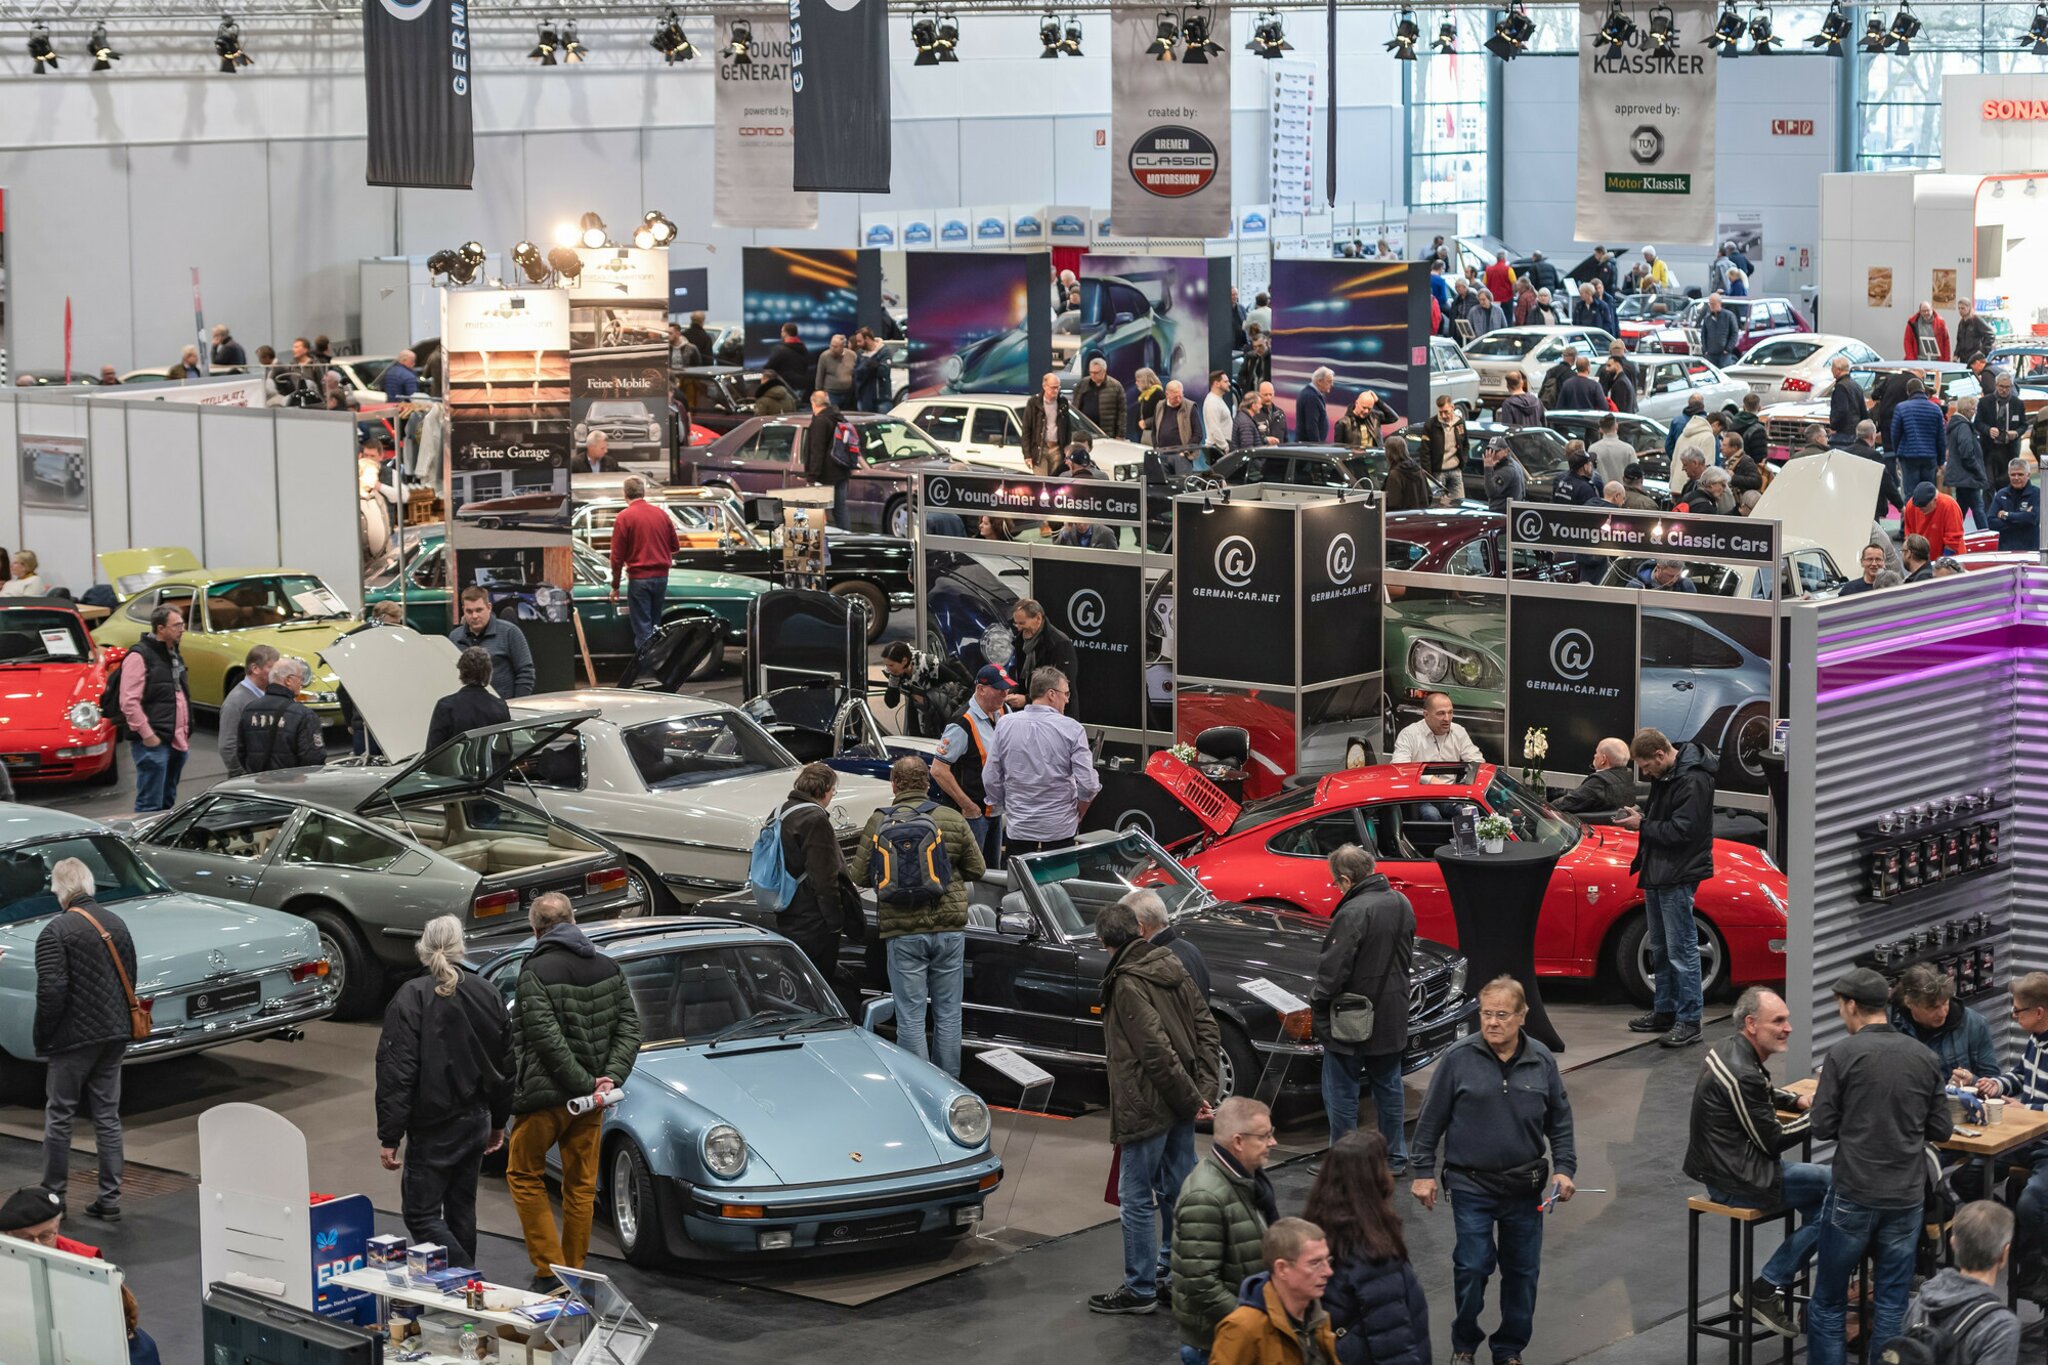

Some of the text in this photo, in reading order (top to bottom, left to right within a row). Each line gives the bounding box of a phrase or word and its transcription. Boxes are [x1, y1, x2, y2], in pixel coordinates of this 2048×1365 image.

[451, 0, 467, 96] GERM
[750, 41, 792, 58] OUNG
[721, 63, 789, 81] GENERAT
[1593, 54, 1704, 75] KLASSIKER
[744, 107, 778, 118] powered
[1147, 107, 1199, 119] created by:
[1615, 103, 1681, 117] approved by:
[1154, 138, 1190, 150] BREMEN
[1135, 156, 1212, 166] CLASSIC
[1146, 174, 1200, 185] MOTORSHOW
[1608, 177, 1687, 191] MotorKlassik
[587, 378, 651, 389] Feine Mobile
[472, 446, 550, 461] Feine Garage
[955, 487, 1035, 507] Youngtimer
[1054, 495, 1102, 511] Classic
[1106, 499, 1138, 514] Cars
[1549, 521, 1645, 544] Youngtimer
[1667, 531, 1726, 550] Classic
[1730, 535, 1769, 553] Cars
[1192, 587, 1281, 603] GERMAN-CAR.NET
[1310, 583, 1372, 602] GERMAN-CAR.NET
[1070, 638, 1129, 653] AN-CAR.NET
[1526, 680, 1620, 697] GERMAN-CAR.NET
[317, 1254, 363, 1288] ERC
